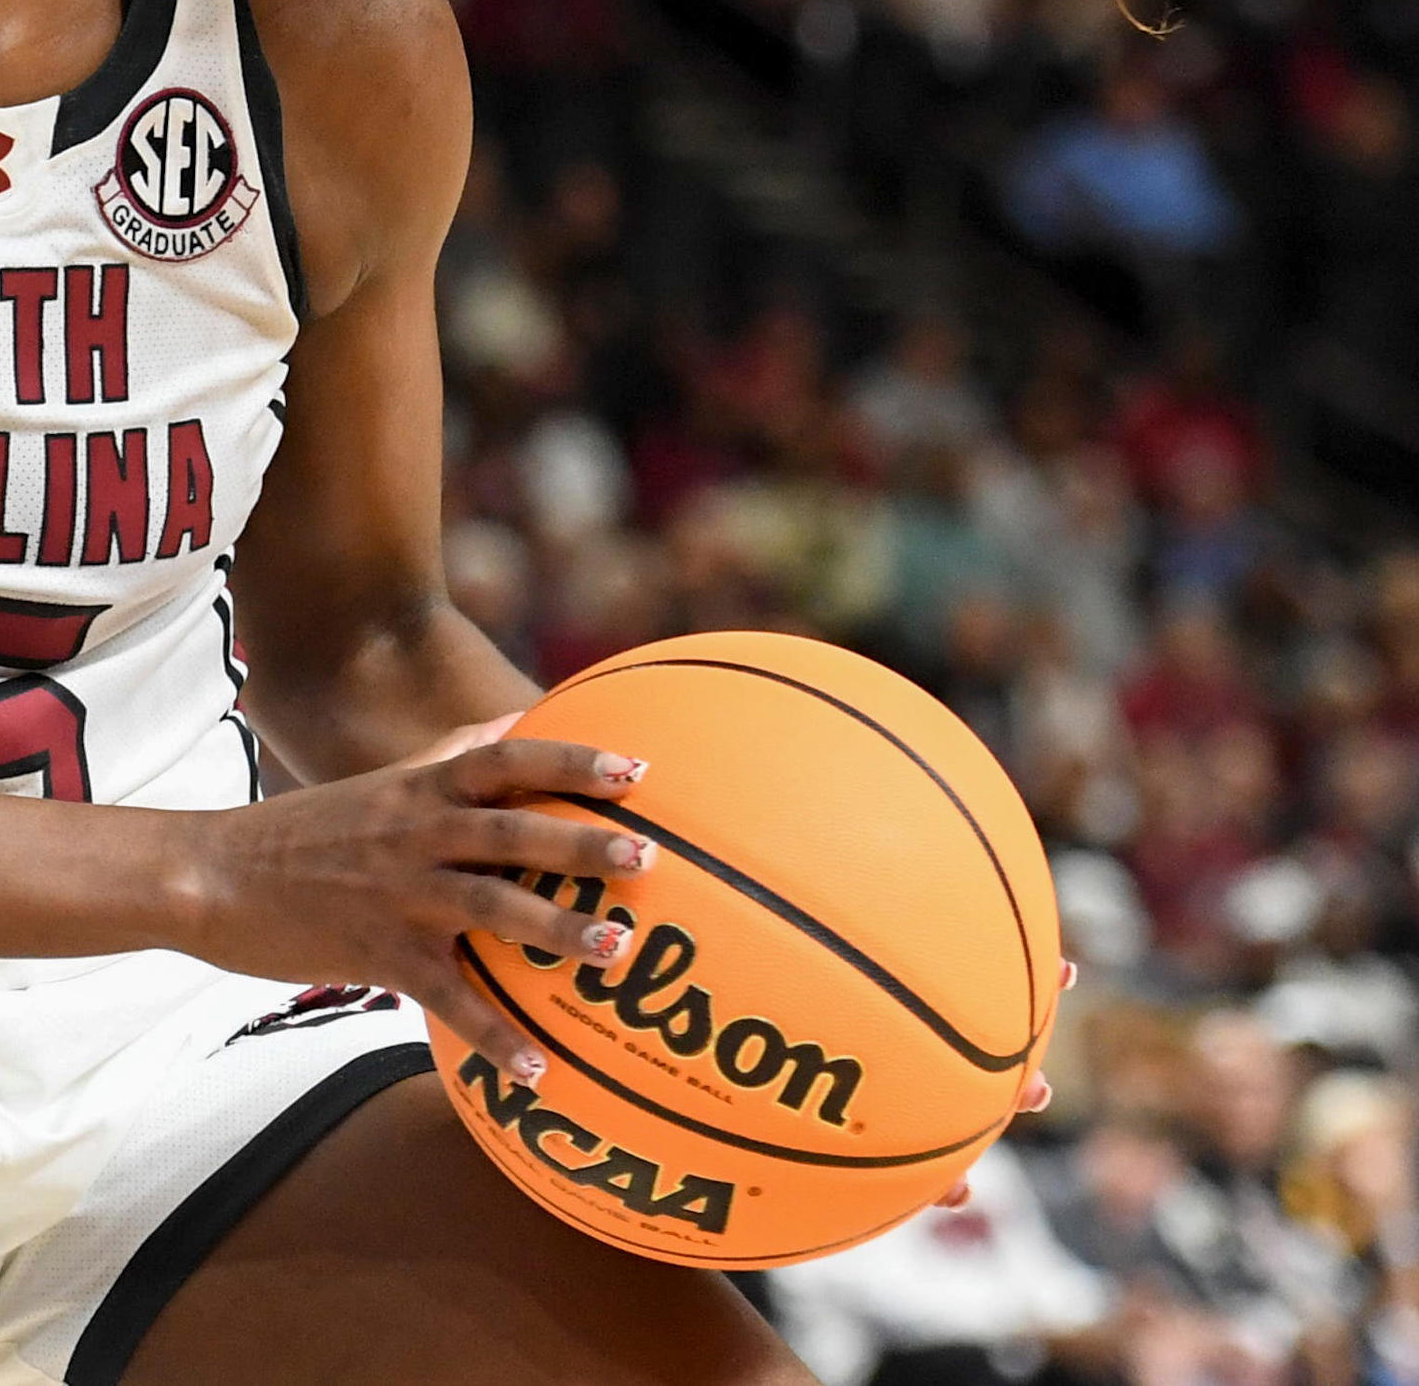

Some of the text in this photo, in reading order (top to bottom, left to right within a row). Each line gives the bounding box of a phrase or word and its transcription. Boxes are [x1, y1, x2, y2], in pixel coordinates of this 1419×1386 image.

[129, 97, 227, 216] SEC
[112, 204, 236, 256] GRADUATE
[549, 993, 735, 1106] INDOOR GAME BALL
[458, 1051, 737, 1235] NCAA
